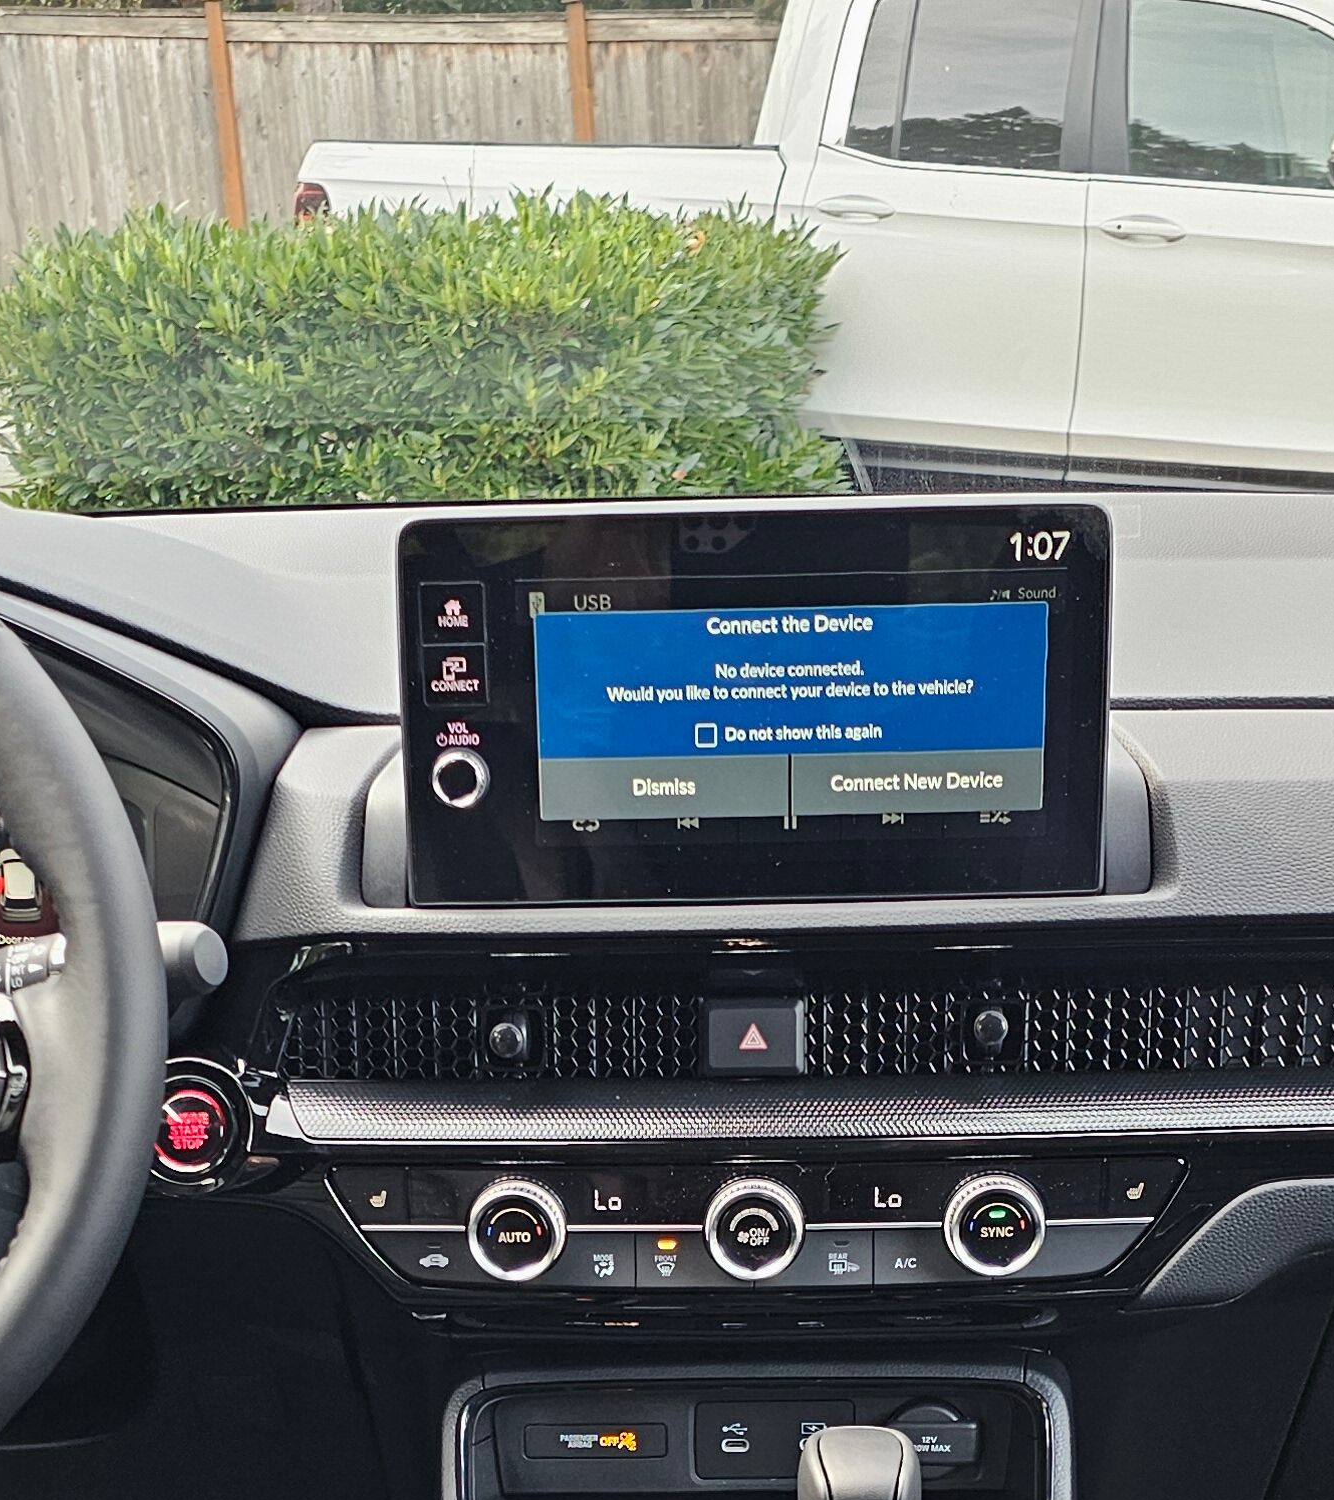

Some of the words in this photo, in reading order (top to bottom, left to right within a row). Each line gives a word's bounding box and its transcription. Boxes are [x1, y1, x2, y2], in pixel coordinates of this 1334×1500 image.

[1009, 530, 1071, 562] 1:07
[1018, 586, 1057, 600] Sound
[573, 594, 612, 611] USB
[437, 615, 469, 628] HOME
[706, 616, 778, 635] Connect
[782, 614, 810, 634] the
[813, 613, 874, 633] Device
[715, 664, 737, 679] No
[740, 662, 784, 678] device
[787, 660, 865, 677] connected.
[430, 679, 480, 692] CONNECT
[606, 686, 654, 702] Would
[656, 687, 683, 704] you
[685, 684, 710, 700] like
[713, 685, 728, 700] to
[730, 684, 786, 700] connect
[790, 684, 823, 701] your
[826, 681, 871, 698] device
[873, 681, 889, 697] to
[891, 680, 916, 696] the
[918, 679, 974, 695] vehicle?
[447, 722, 469, 734] VOL
[724, 726, 747, 742] Do
[749, 726, 773, 742] not
[775, 725, 813, 741] show
[816, 724, 842, 740] this
[845, 724, 882, 742] again
[448, 734, 480, 746] AUDIO
[632, 777, 696, 797] Dismiss
[830, 774, 900, 793] Connect
[904, 773, 942, 791] New
[946, 771, 1003, 790] Device
[170, 1125, 206, 1136] START
[173, 1139, 204, 1150] STOP
[498, 1232, 531, 1243] AUTO
[980, 1226, 1014, 1239] SYNC
[749, 1237, 770, 1247] OFF
[895, 1257, 917, 1269] A/C
[599, 1436, 620, 1447] OFF
[921, 1436, 938, 1444] 12V
[930, 1444, 951, 1453] MAX
